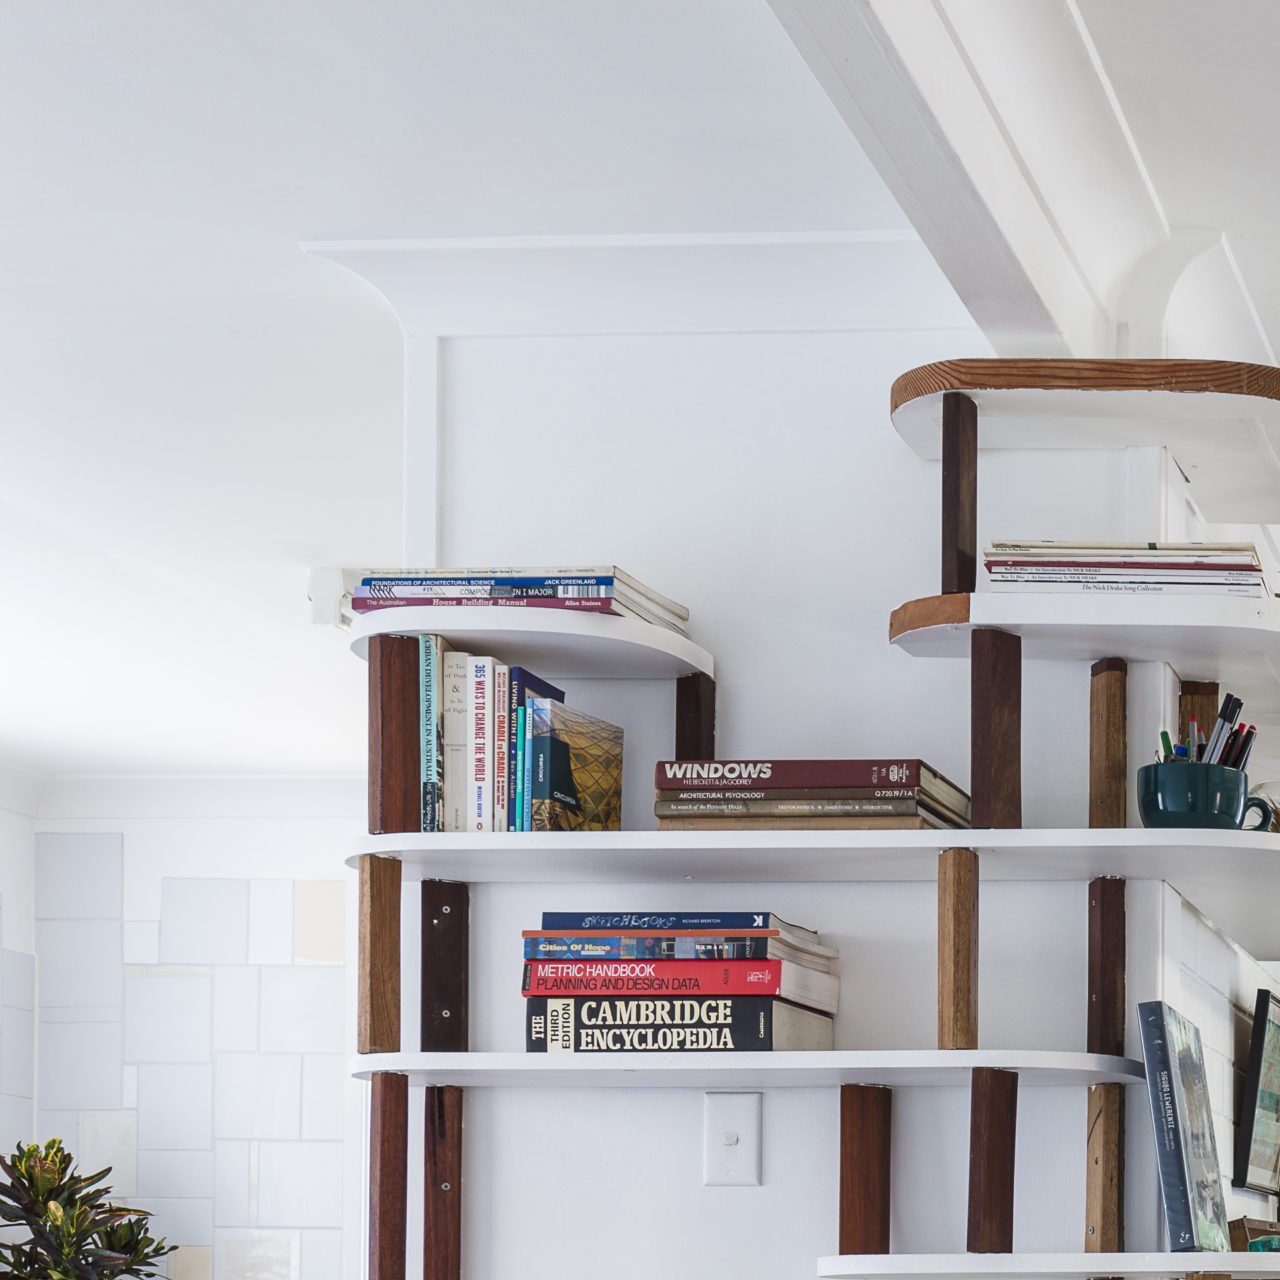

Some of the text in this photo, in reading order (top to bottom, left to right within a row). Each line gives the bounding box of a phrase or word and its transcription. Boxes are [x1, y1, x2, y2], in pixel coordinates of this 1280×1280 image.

[461, 599, 493, 607] Building
[528, 588, 554, 596] MAJOR
[424, 640, 432, 667] URBAN
[424, 668, 432, 727] DEVELOPMENT
[424, 727, 432, 737] IN
[474, 664, 486, 782] 365 WAYS TO CHANGE THE WORLD
[496, 714, 506, 742] CRADLE
[510, 712, 518, 735] WITH
[511, 735, 518, 743] IT
[425, 738, 433, 782] AUSTRALIA
[496, 750, 506, 779] CRADLE
[664, 763, 772, 778] WINDOWS
[538, 943, 611, 952] Cities Of Hope
[537, 964, 584, 977] METRIC
[586, 963, 656, 977] HANDBOOK
[536, 977, 701, 990] PLANNING AND DESIGN DATA
[580, 1000, 732, 1025] CAMBRIDGE
[532, 1015, 545, 1040] THE
[550, 1009, 560, 1043] THIRD
[561, 1002, 571, 1049] EDITION
[579, 1028, 735, 1050] ENCYCLOPEDIA
[1164, 1093, 1175, 1128] LEWERENTZ
